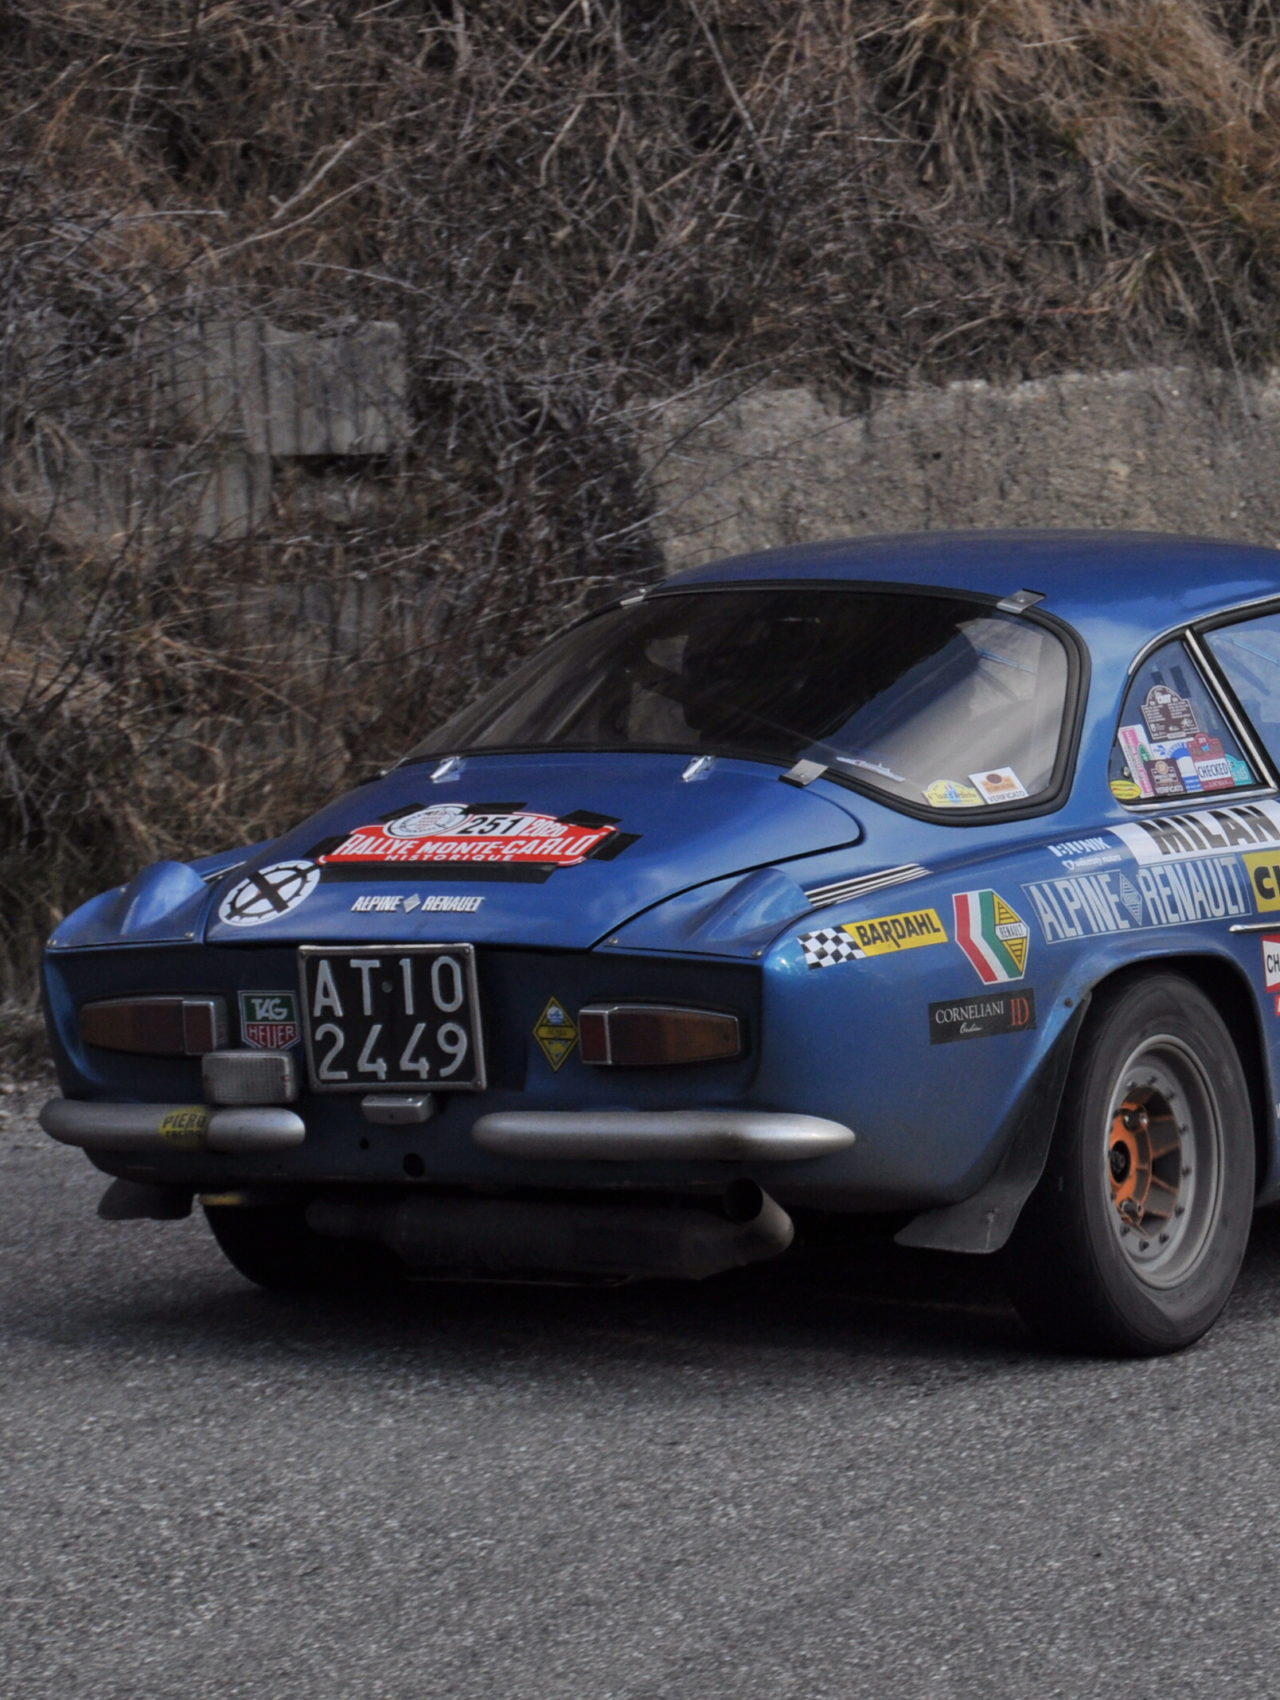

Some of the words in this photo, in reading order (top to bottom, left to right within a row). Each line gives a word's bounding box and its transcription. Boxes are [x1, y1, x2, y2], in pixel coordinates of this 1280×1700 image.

[1197, 762, 1229, 778] CHECKED
[456, 815, 525, 836] 251
[331, 834, 420, 856] RALLYE
[416, 834, 600, 856] MONTE-CARLO
[384, 854, 515, 862] HISTORIQUE
[350, 895, 404, 912] ALPINE
[421, 895, 486, 913] RENAULT
[1028, 869, 1130, 942] ALPINE
[1138, 856, 1247, 926] RENAULT
[855, 912, 942, 949] BARDAHL
[251, 997, 289, 1021] TAG
[935, 1000, 1004, 1024] CORNELIANI
[1009, 997, 1030, 1026] ID
[248, 1025, 294, 1049] HEUER
[314, 1021, 469, 1082] 2449
